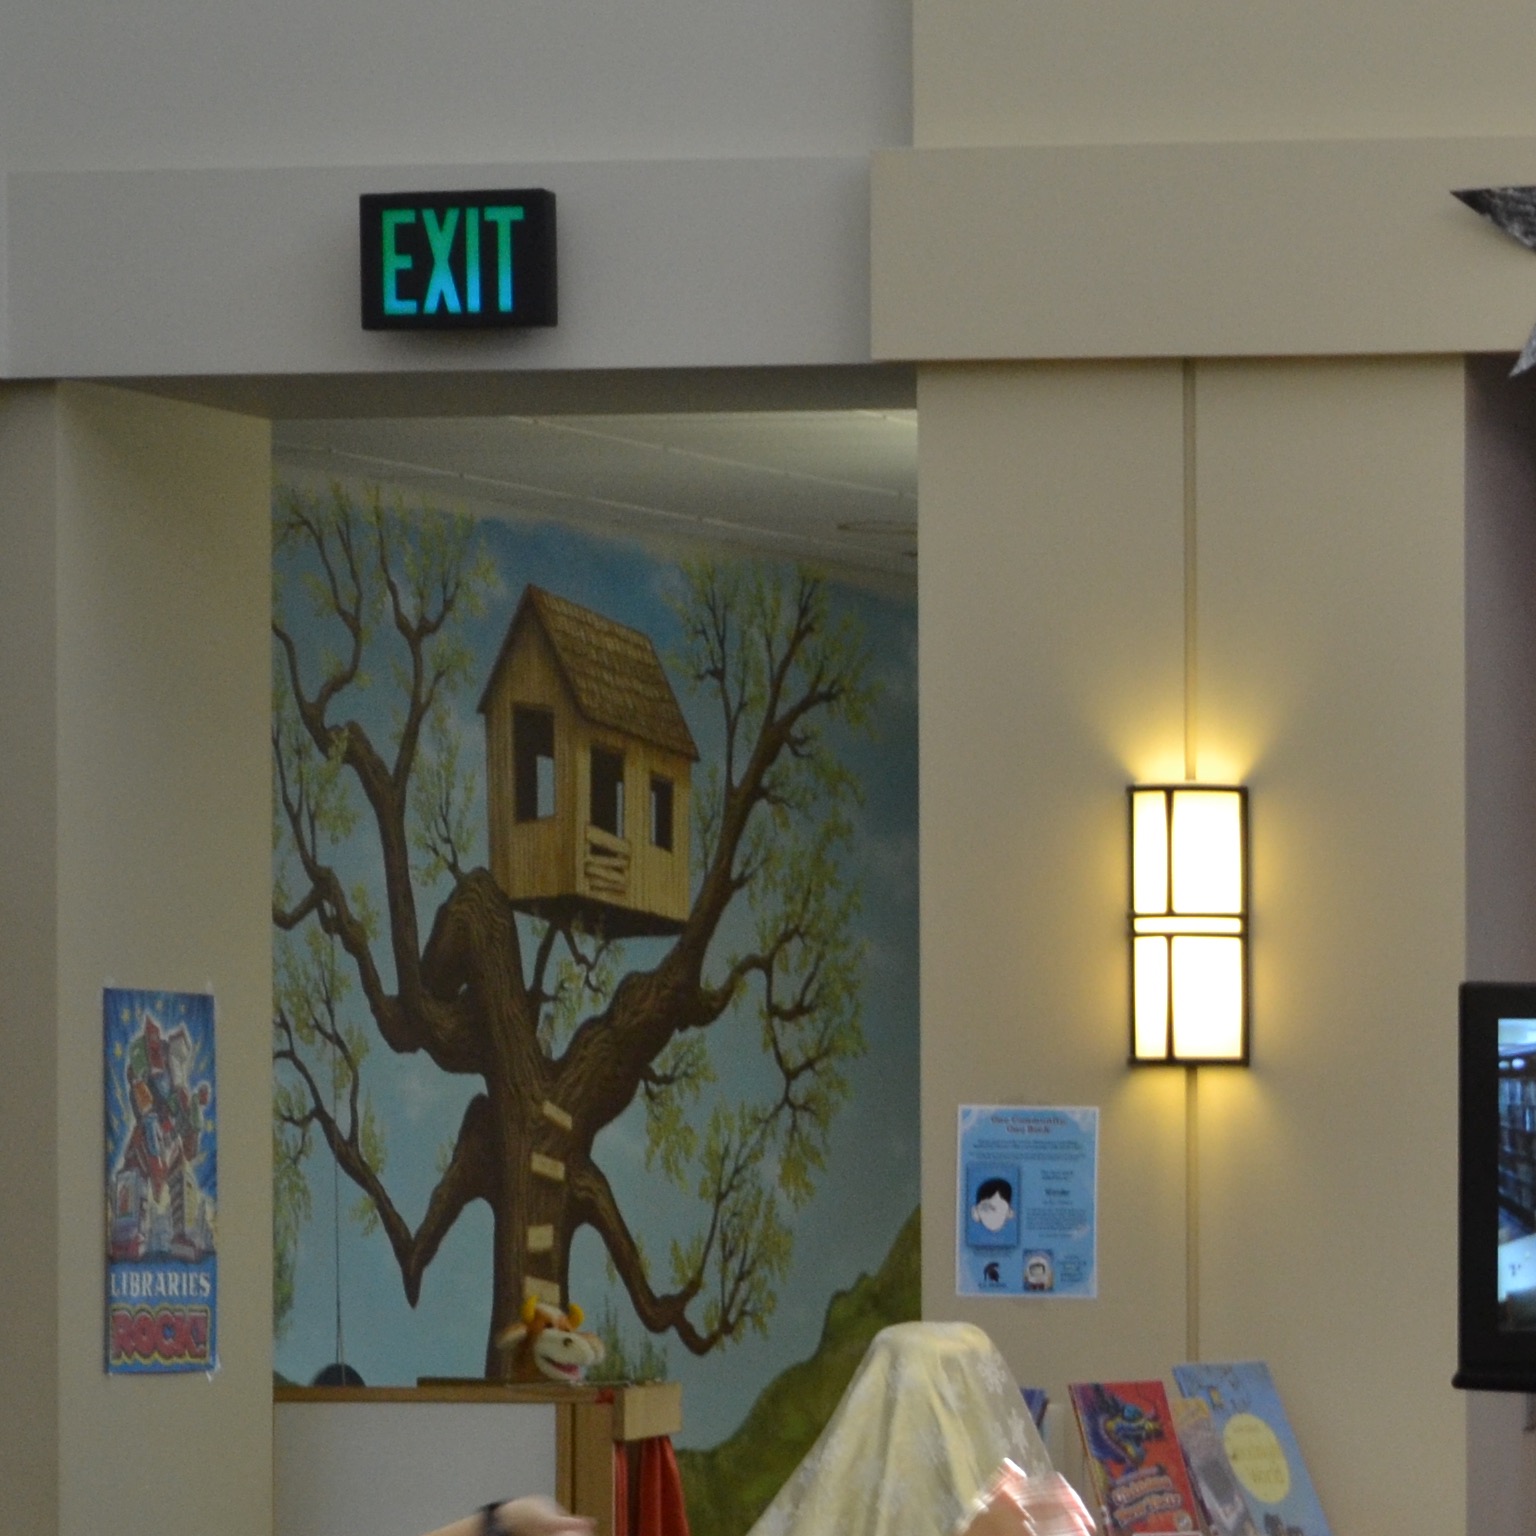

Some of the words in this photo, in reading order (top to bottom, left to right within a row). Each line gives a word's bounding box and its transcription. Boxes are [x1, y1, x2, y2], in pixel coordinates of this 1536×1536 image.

[381, 206, 524, 316] EXIT
[110, 1271, 211, 1297] LIBRARIES
[111, 1307, 208, 1361] ROCK!
